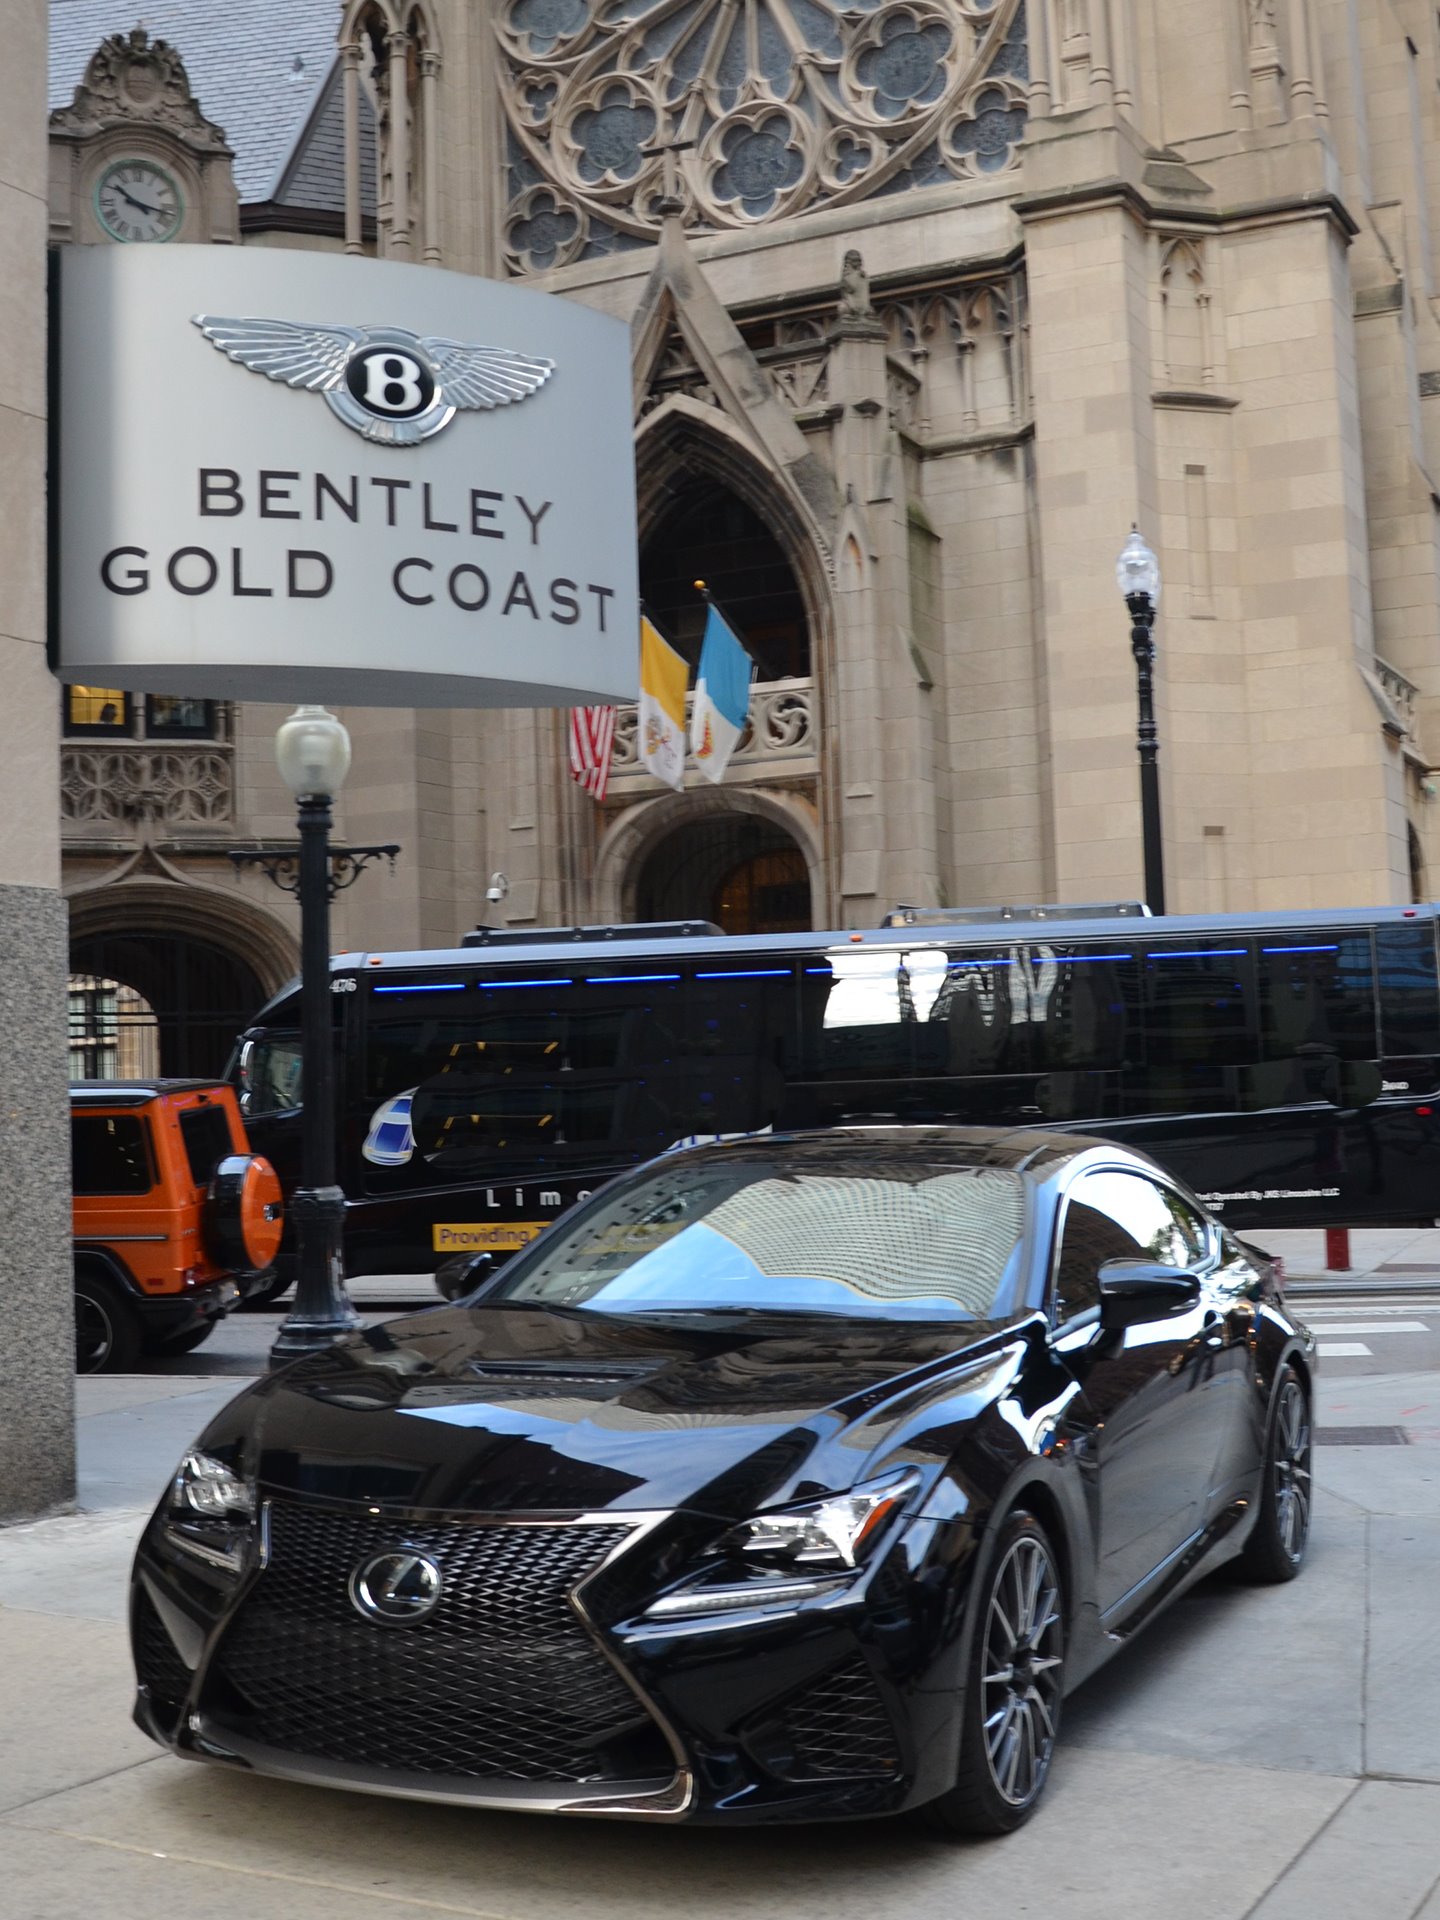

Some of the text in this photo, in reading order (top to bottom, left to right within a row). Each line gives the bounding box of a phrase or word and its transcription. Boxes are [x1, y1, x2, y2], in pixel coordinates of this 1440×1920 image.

[198, 467, 554, 546] BENTLEY
[99, 545, 616, 632] GOLD COAST
[439, 1227, 530, 1247] Providing
